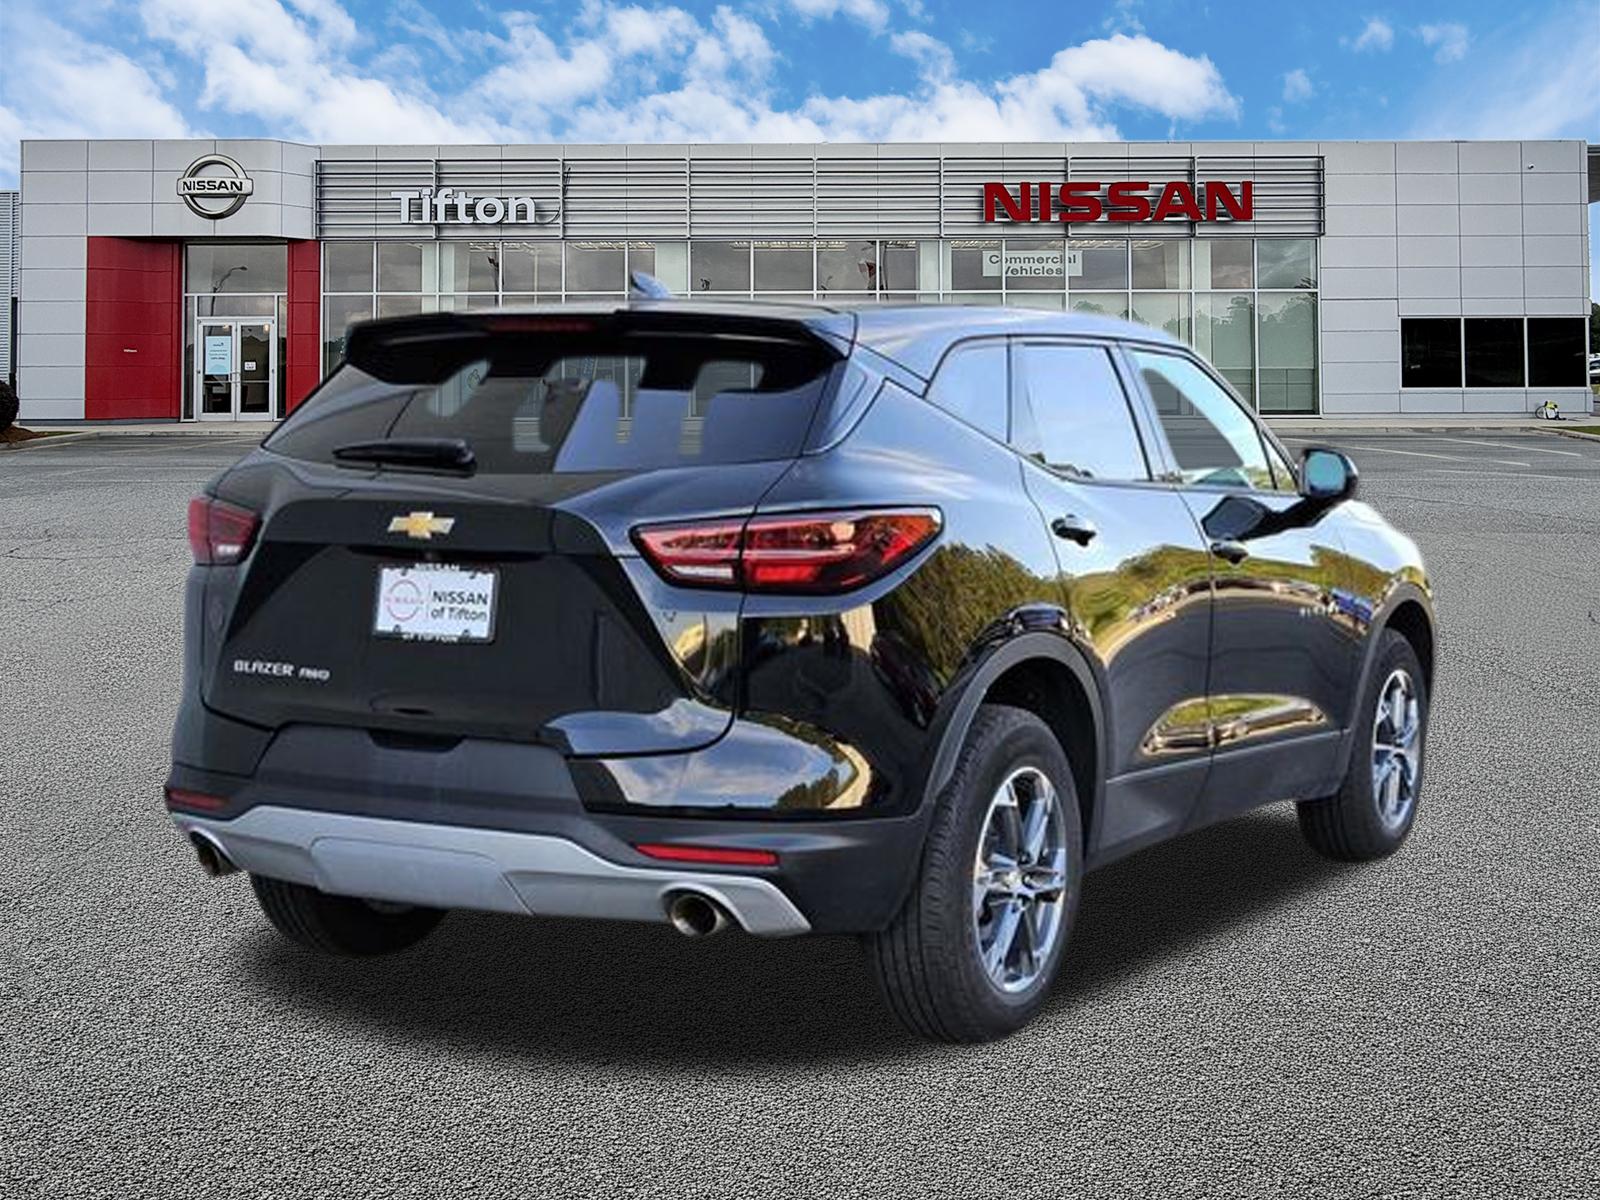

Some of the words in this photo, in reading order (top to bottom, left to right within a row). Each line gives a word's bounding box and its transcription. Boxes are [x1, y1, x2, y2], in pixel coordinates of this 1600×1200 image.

[182, 180, 243, 191] NISSAN
[391, 188, 536, 224] Tifton
[984, 181, 1253, 222] NISSAN
[432, 591, 487, 605] NISSAN
[431, 606, 445, 619] of
[448, 606, 487, 621] Tifton
[233, 659, 294, 676] BLAZER
